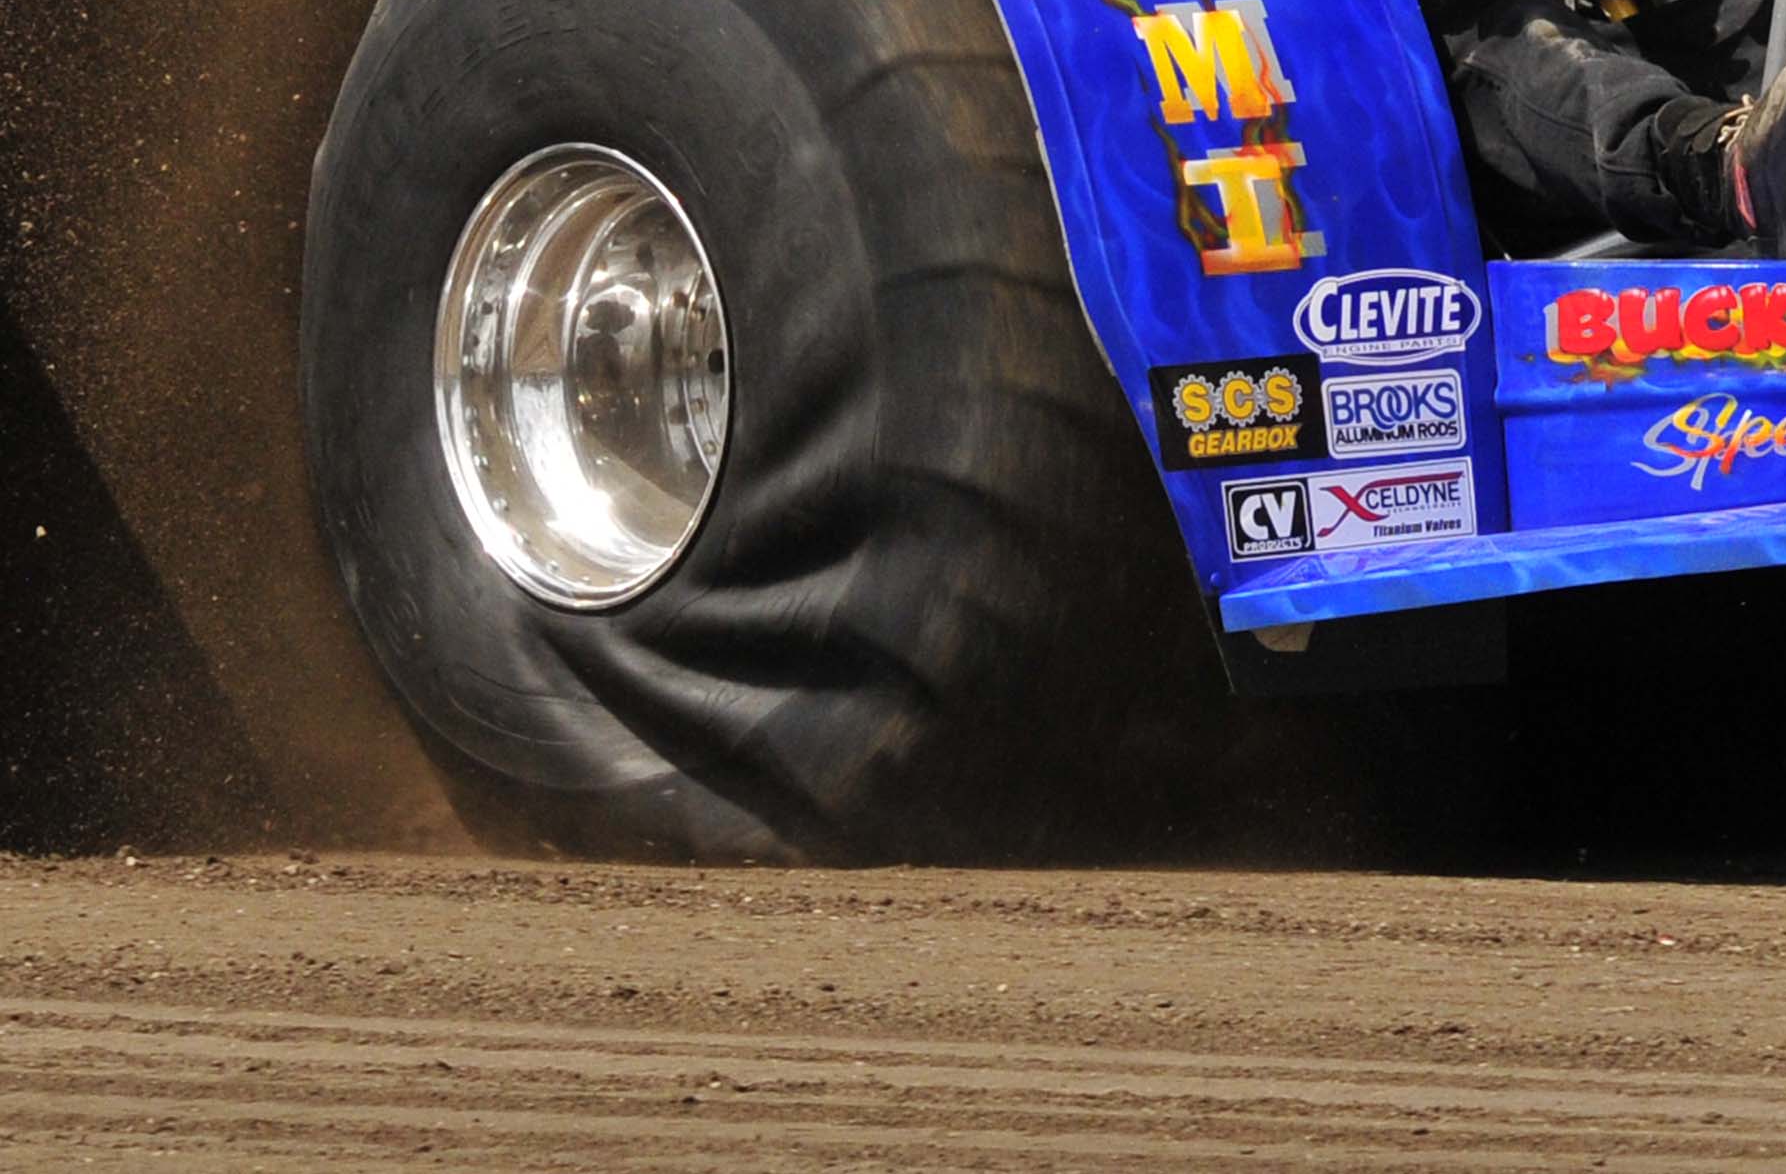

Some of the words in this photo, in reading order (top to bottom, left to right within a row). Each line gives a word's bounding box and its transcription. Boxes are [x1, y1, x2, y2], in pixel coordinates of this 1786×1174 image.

[1309, 281, 1461, 342] CLEVITE
[1322, 342, 1391, 356] ENGINE
[1400, 337, 1457, 350] PARTS
[1181, 374, 1296, 423] SCS
[1330, 382, 1457, 430] BROOKS
[1188, 426, 1300, 457] GEARBOX
[1335, 425, 1415, 444] ALUMINUM
[1418, 421, 1458, 438] RODS
[1239, 490, 1297, 540] CV
[1373, 521, 1423, 538] Titanium
[1426, 517, 1461, 533] Valves
